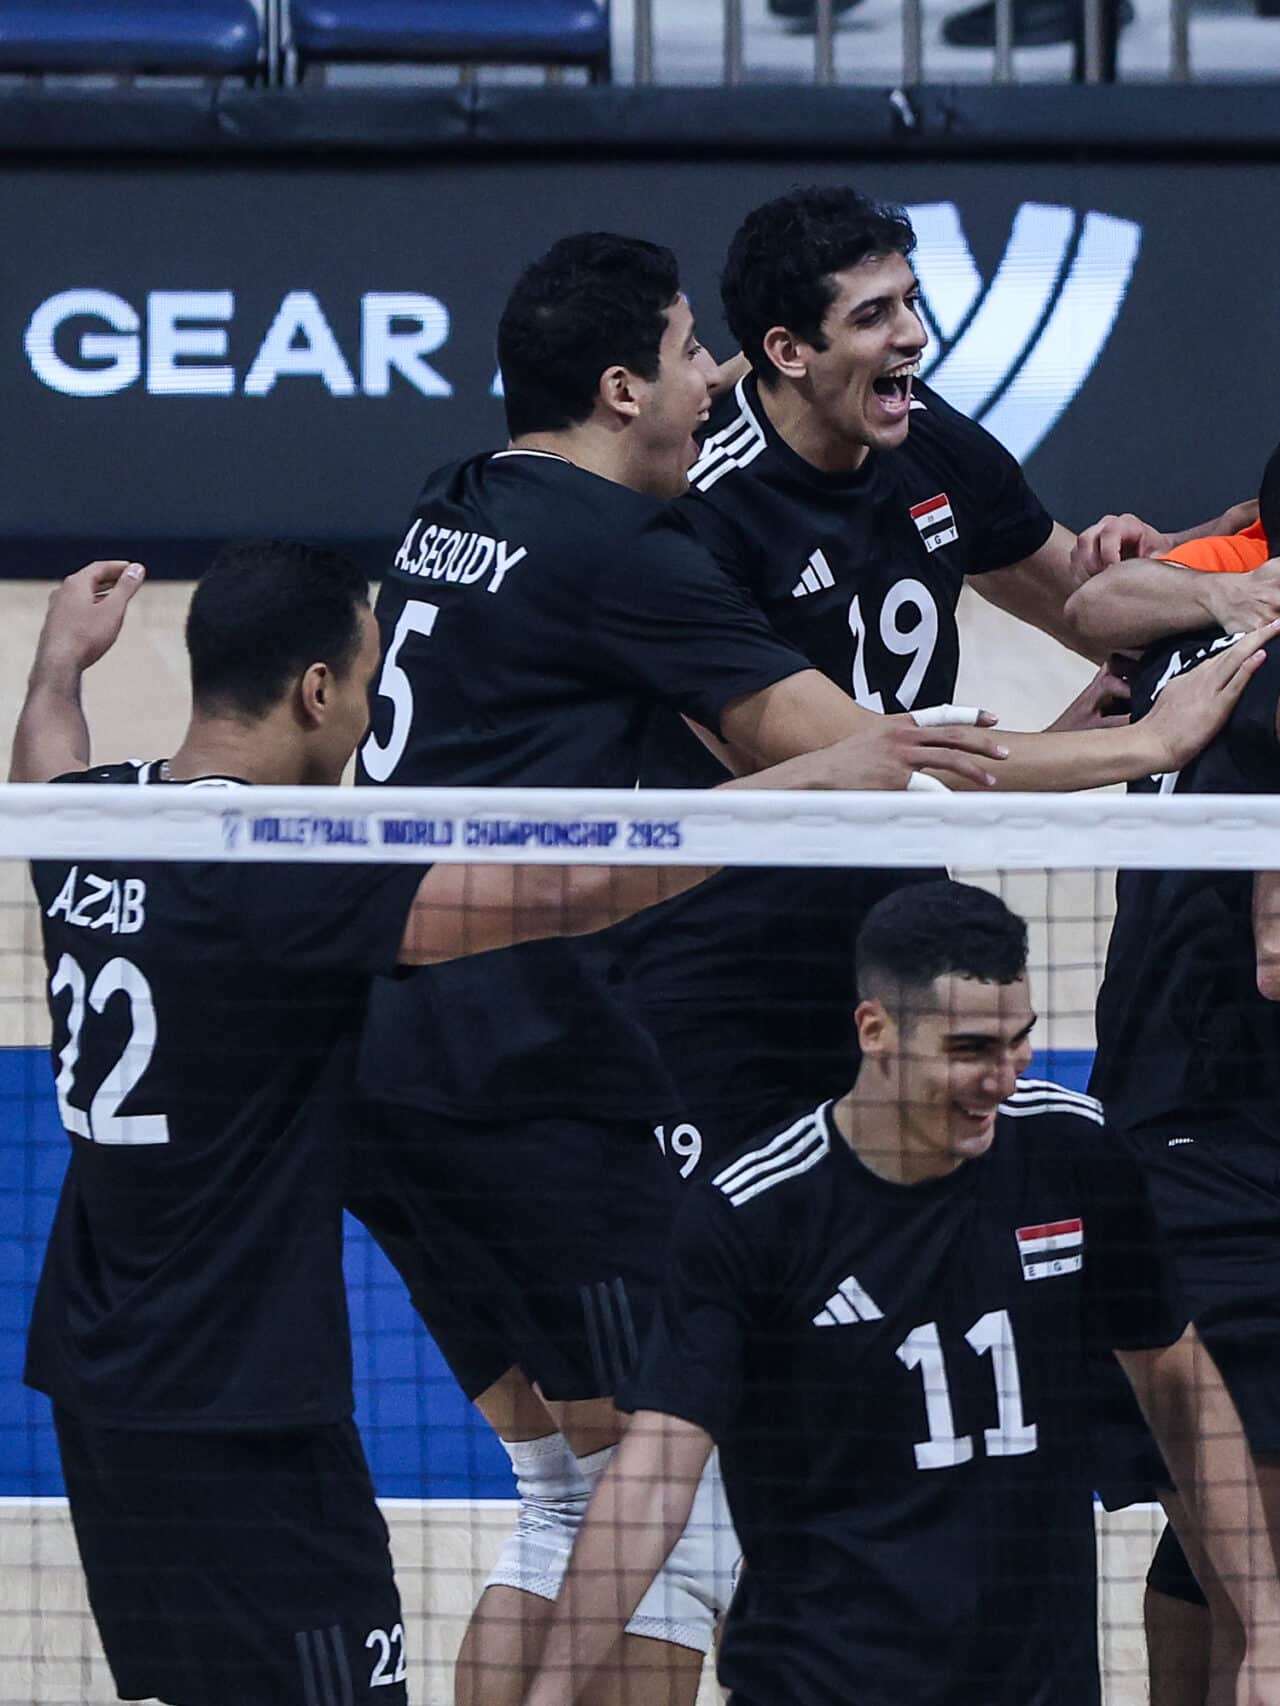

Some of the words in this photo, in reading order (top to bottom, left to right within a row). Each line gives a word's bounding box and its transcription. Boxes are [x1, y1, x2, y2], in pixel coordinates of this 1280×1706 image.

[24, 288, 453, 396] GEAR
[394, 518, 528, 593] A.SEOUDY
[848, 576, 938, 713] 19
[361, 600, 440, 782] 5
[382, 819, 453, 845] WORLD
[465, 820, 617, 847] CHAMPIONSHIP
[47, 865, 146, 934] AZAB
[50, 952, 170, 1144] 22
[653, 1123, 703, 1179] 19
[895, 1309, 1038, 1470] 11
[364, 1623, 408, 1688] 22
